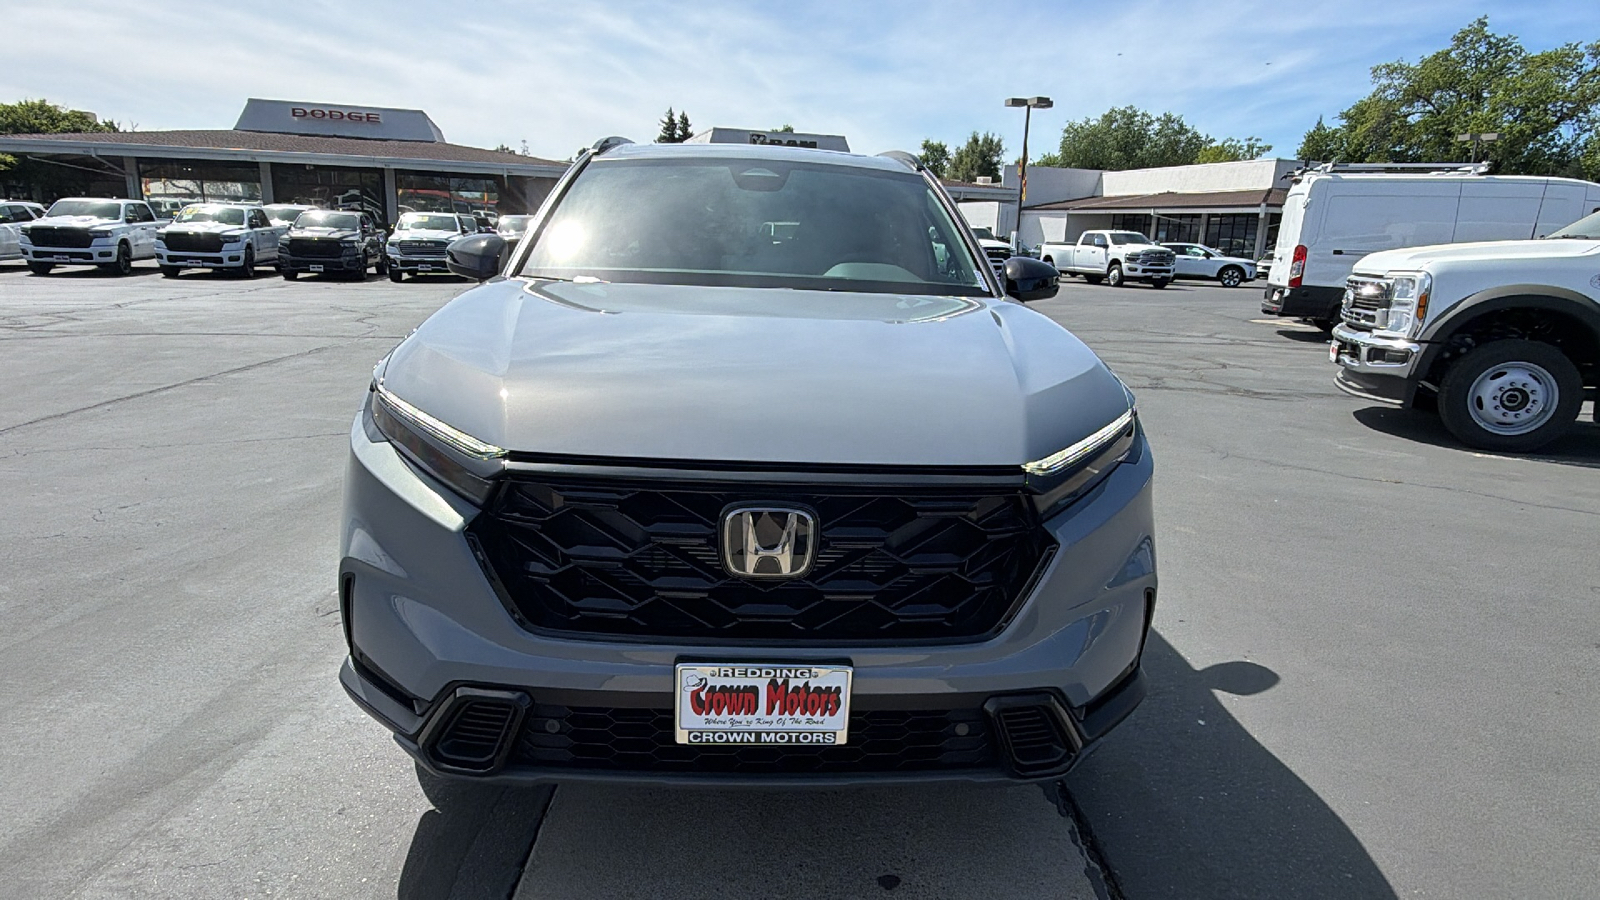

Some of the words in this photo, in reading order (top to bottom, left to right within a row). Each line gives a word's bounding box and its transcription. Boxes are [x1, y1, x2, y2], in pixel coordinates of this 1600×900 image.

[291, 107, 381, 123] DODGE
[719, 668, 810, 678] REDDING
[690, 679, 759, 716] Crown
[765, 679, 842, 717] Motors
[704, 717, 727, 725] Where
[755, 717, 774, 727] King
[776, 717, 787, 727] Of
[789, 717, 802, 725] The
[805, 717, 825, 726] Road
[689, 732, 756, 743] CROWN
[760, 732, 835, 743] MOTORS
